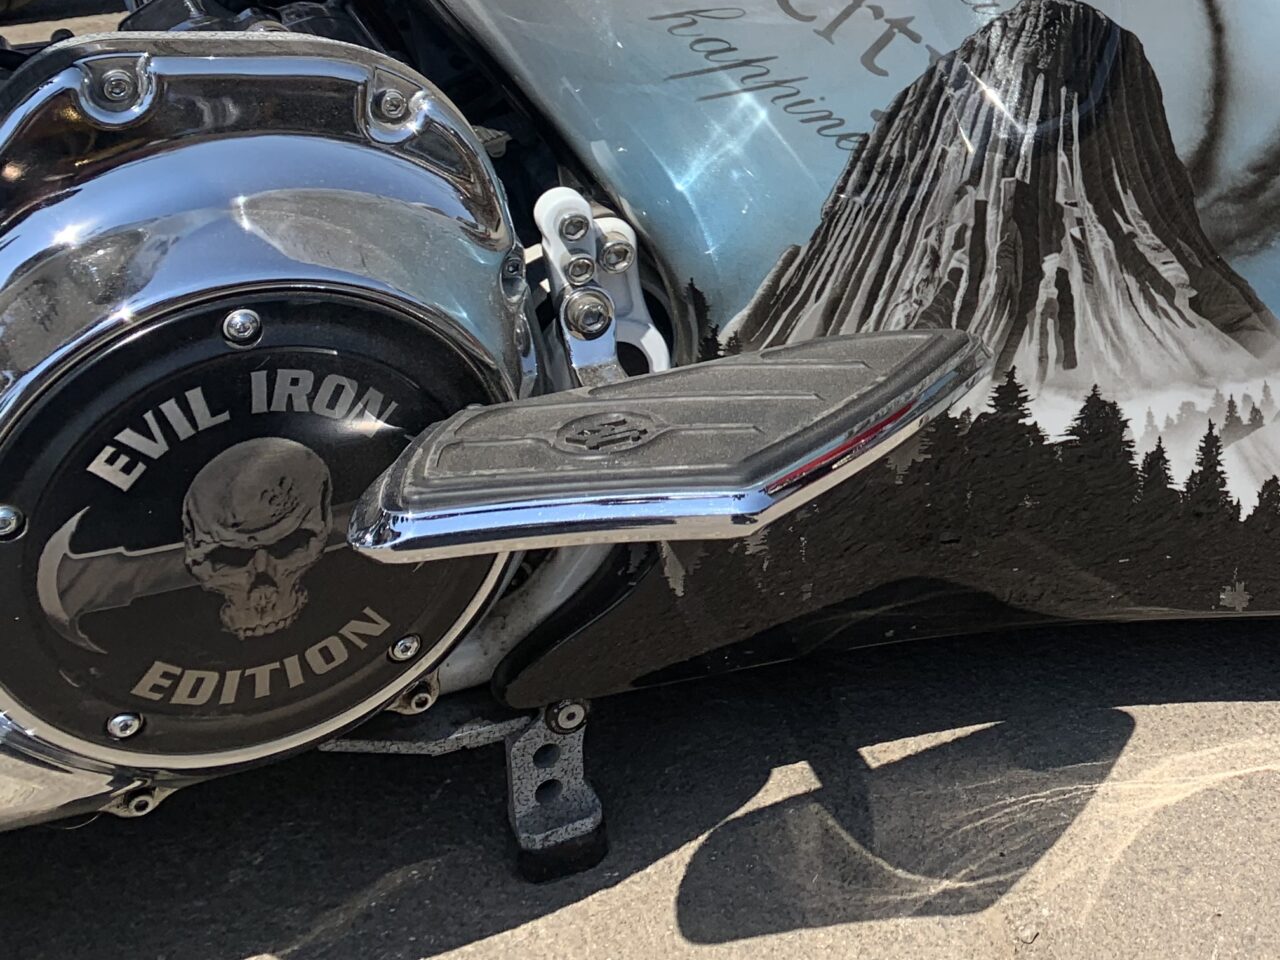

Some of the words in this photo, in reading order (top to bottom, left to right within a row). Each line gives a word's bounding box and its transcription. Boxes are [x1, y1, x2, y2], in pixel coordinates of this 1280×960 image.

[87, 386, 230, 492] EVIL
[250, 369, 398, 440] IRON
[131, 608, 391, 706] EDITION
